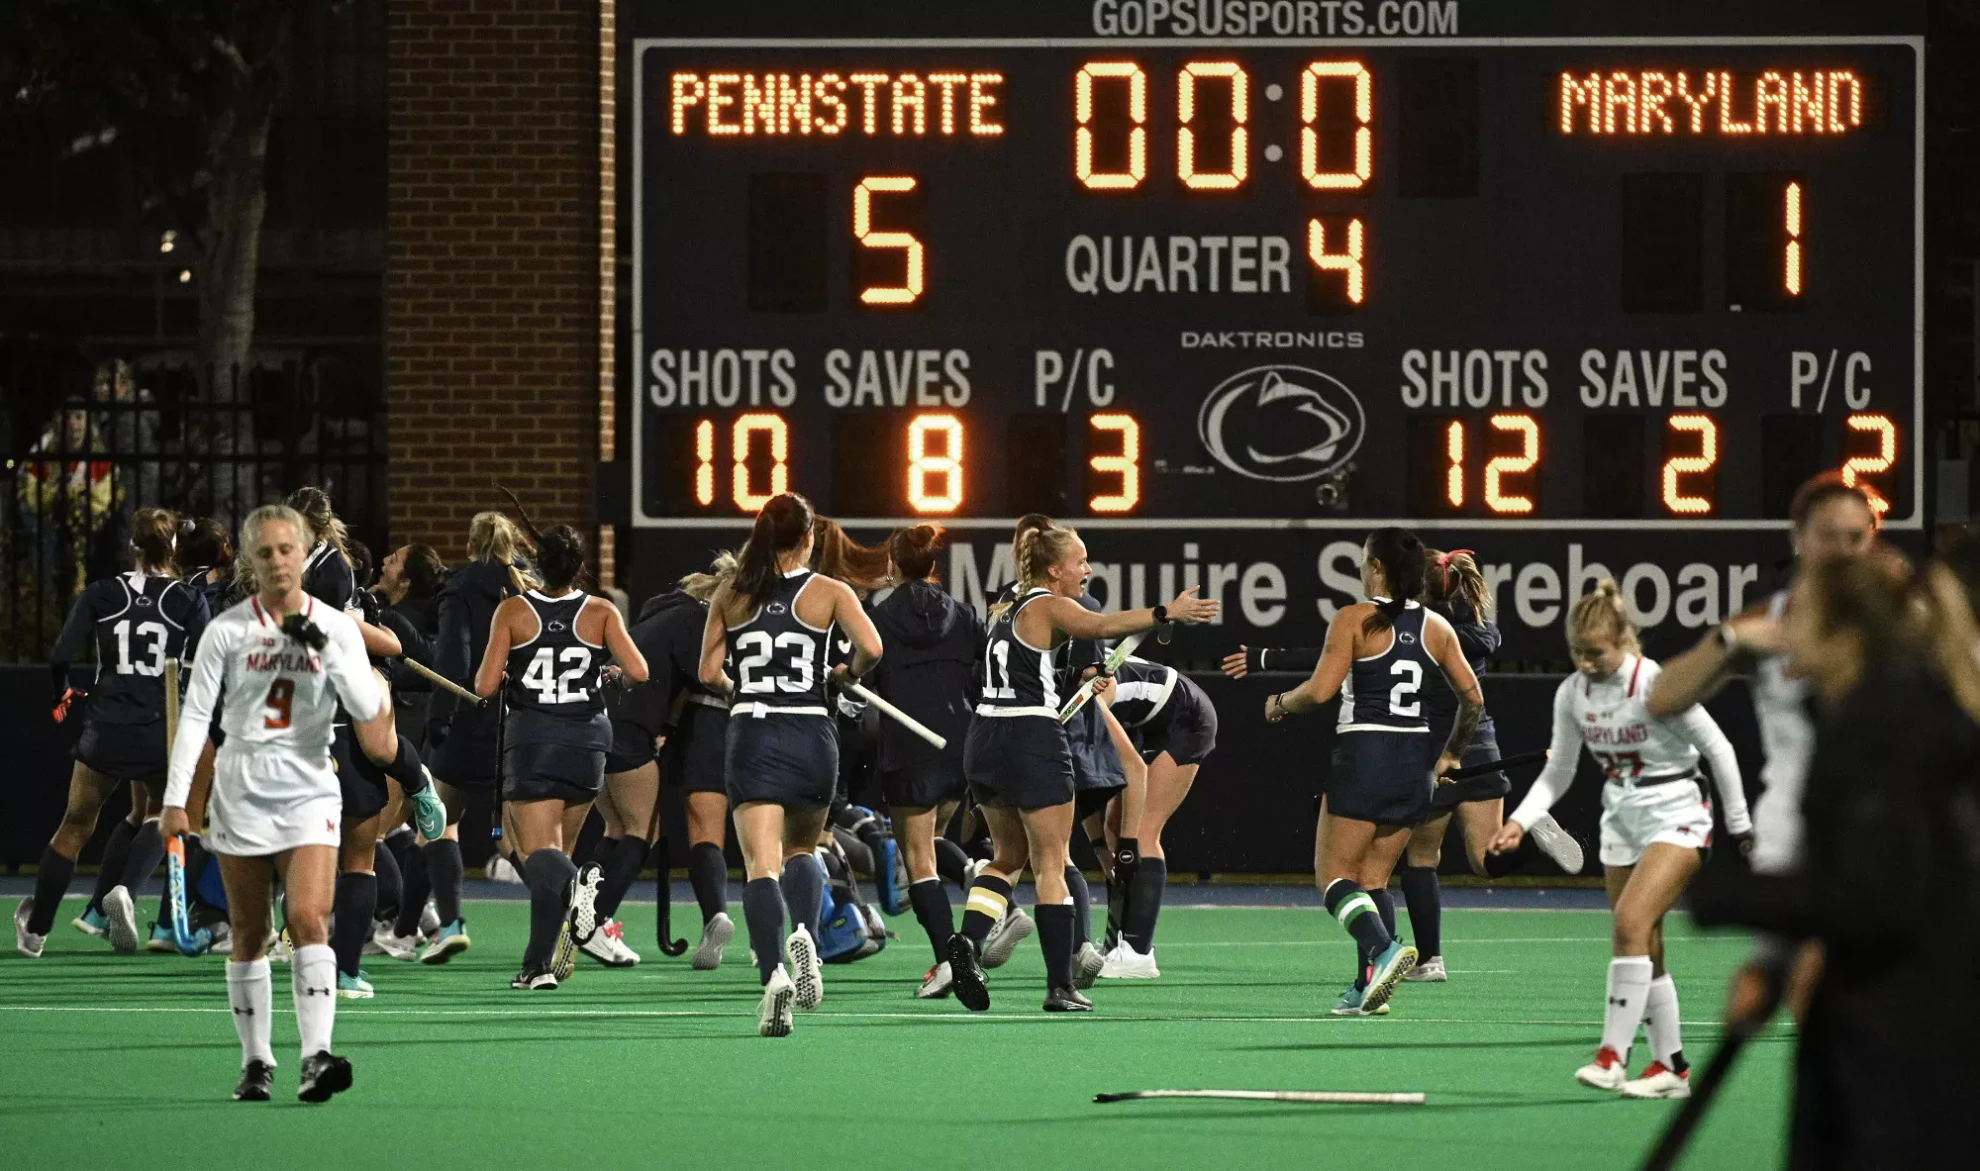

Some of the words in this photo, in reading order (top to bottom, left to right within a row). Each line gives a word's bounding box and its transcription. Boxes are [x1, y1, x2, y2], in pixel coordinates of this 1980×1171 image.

[671, 72, 1003, 136] PENNSTATE
[1560, 70, 1861, 134] MARYLAND
[854, 176, 923, 304] 5
[1065, 234, 1291, 295] QUARTER
[1307, 217, 1364, 304] 4
[1785, 181, 1801, 296] 1
[1180, 331, 1365, 349] DAKTRONICS
[650, 348, 797, 408] SHOTS
[824, 348, 971, 408] SAVES
[1035, 348, 1115, 412] P/C
[1401, 348, 1549, 408] SHOTS
[1579, 348, 1728, 408] SAVES
[1790, 349, 1872, 413] P/C
[696, 413, 788, 513] 10
[907, 414, 964, 513] 8
[1090, 414, 1139, 512] 3
[1447, 414, 1540, 513] 12
[1662, 414, 1718, 513] 2
[1842, 414, 1895, 513] 2
[949, 541, 1288, 629] Mguire
[112, 620, 169, 676] 13
[521, 646, 592, 704] 42
[735, 629, 816, 694] 23
[263, 677, 295, 729] 9
[1388, 659, 1424, 717] 2
